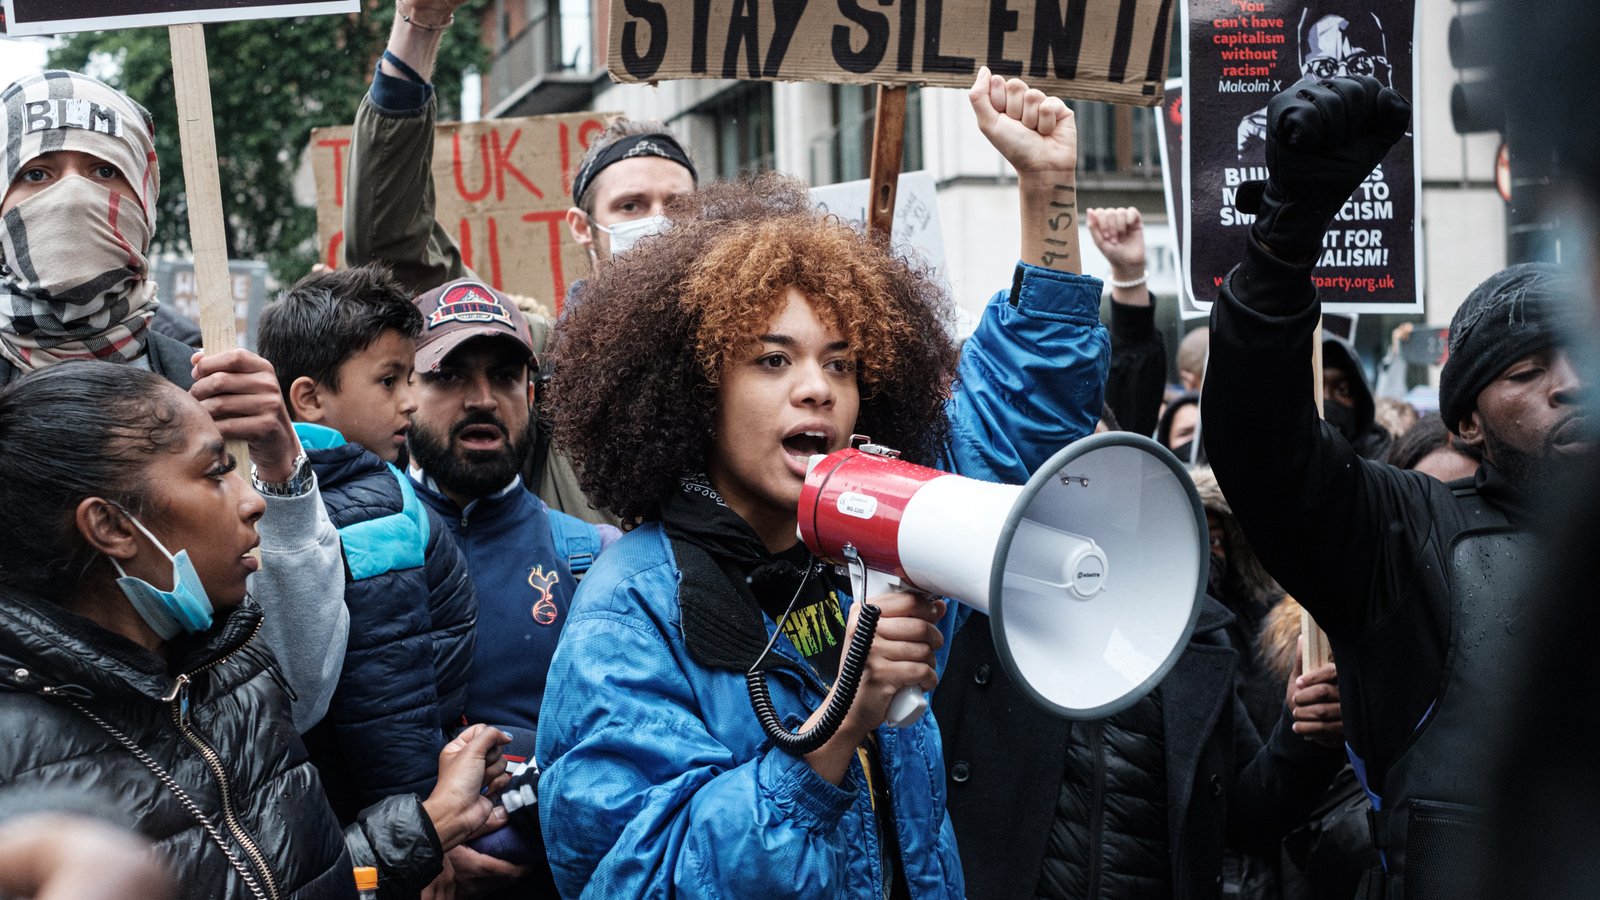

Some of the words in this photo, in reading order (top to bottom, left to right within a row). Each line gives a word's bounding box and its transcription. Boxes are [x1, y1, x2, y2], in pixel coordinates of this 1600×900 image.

[1213, 15, 1248, 28] can't
[1251, 15, 1284, 28] have
[1213, 31, 1285, 47] capitalism
[1221, 47, 1277, 60] without
[1223, 62, 1277, 76] racism"
[1218, 79, 1270, 92] Malcolm
[1272, 80, 1282, 92] X
[25, 100, 117, 134] BLM
[453, 128, 544, 202] UK
[1360, 183, 1390, 201] TO
[1345, 229, 1383, 247] FOR
